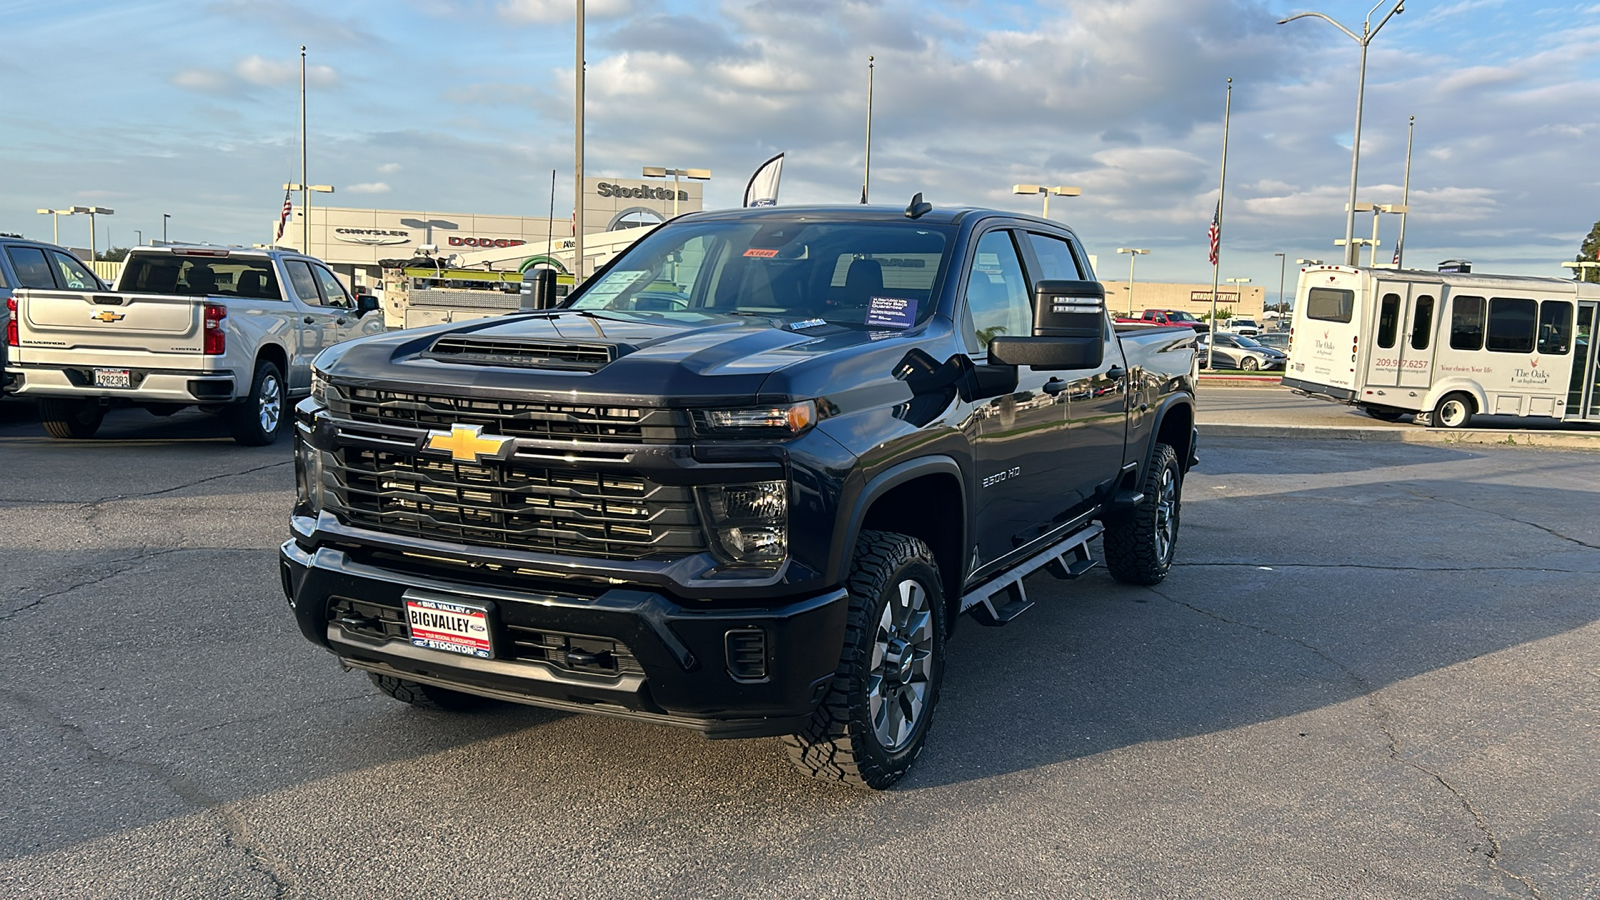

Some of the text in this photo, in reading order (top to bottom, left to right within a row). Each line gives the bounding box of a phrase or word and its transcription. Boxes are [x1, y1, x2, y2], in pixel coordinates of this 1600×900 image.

[597, 182, 689, 201] Stockton
[335, 228, 409, 237] CHRYSLER
[448, 236, 527, 248] DODGE
[1515, 369, 1550, 379] The Oaks
[982, 466, 1020, 489] 2500 HD
[422, 601, 465, 613] BIG VALLEY
[411, 610, 469, 633] BIGVALLEY
[429, 641, 474, 654] STOCKTON
